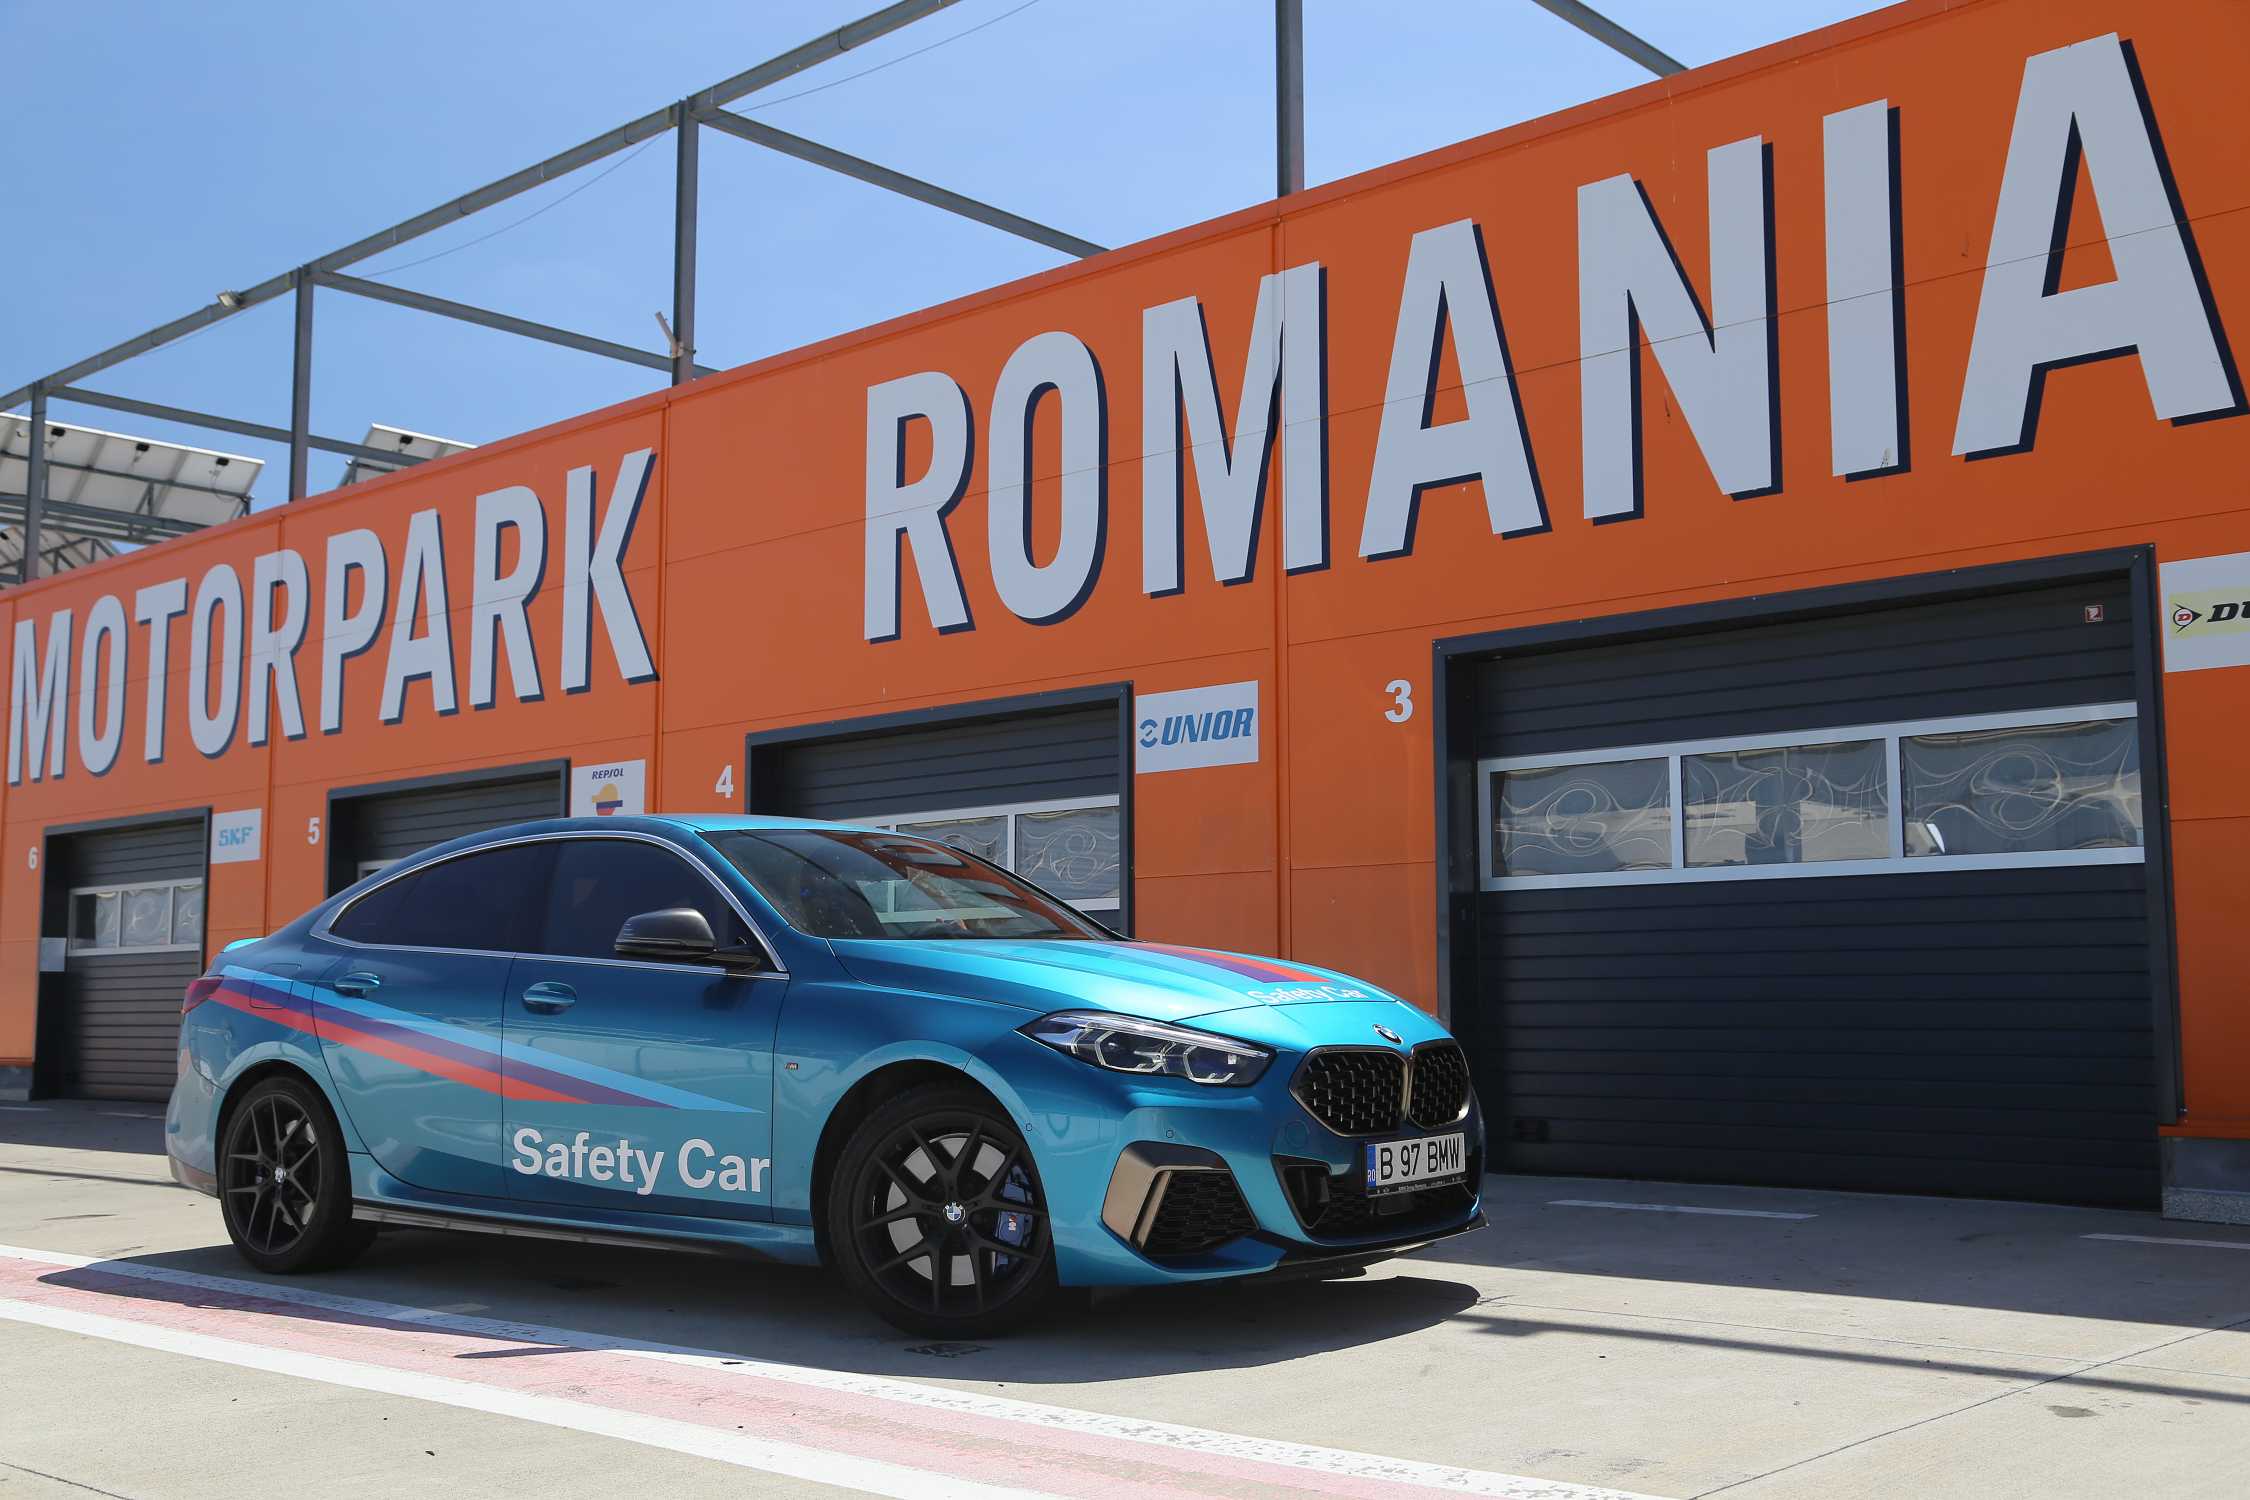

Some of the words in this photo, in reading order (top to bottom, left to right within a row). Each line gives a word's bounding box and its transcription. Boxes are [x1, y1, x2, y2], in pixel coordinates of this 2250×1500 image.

[8, 447, 658, 784] MOTORPARK
[864, 32, 2242, 642] ROMANIA
[1385, 680, 1413, 722] 3
[1161, 708, 1254, 745] UNIOR
[592, 768, 624, 779] REPSOL
[716, 765, 733, 798] 4
[218, 826, 253, 847] SKF
[307, 817, 320, 845] 5
[28, 847, 38, 870] 6
[1248, 986, 1336, 1004] Safety
[511, 1128, 665, 1196] Safety
[678, 1138, 770, 1193] Car
[1381, 1147, 1393, 1180] B
[1401, 1143, 1420, 1176] 97
[1427, 1137, 1460, 1173] BMW
[1367, 1168, 1376, 1183] RO
